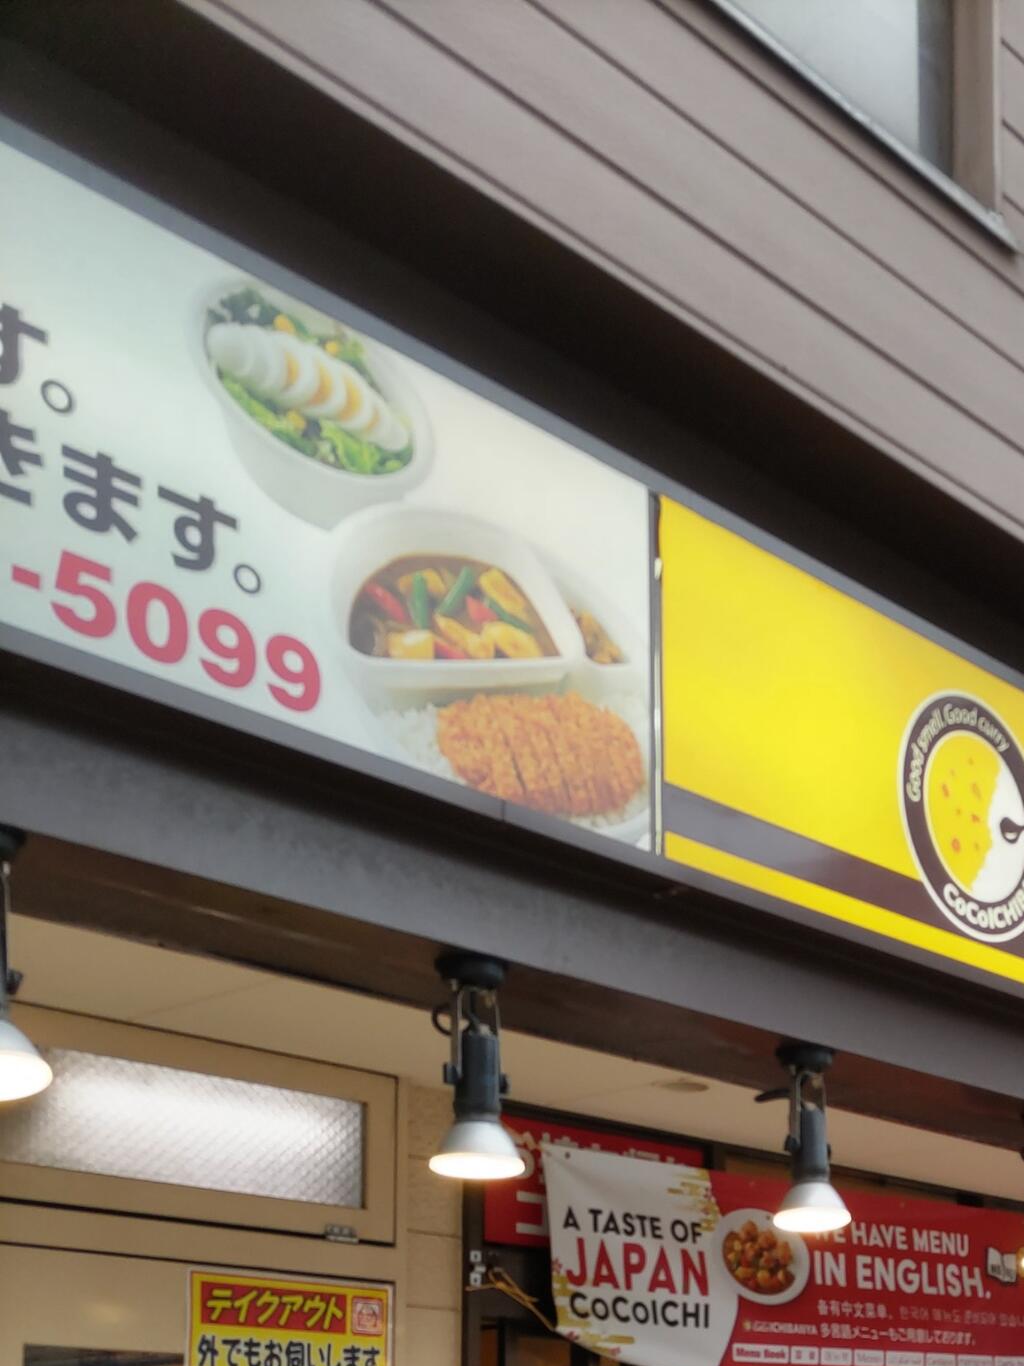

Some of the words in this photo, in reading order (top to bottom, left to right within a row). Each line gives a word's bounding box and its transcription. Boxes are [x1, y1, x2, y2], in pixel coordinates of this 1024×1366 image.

[11, 550, 322, 713] -5099
[563, 1206, 580, 1231] A
[588, 1208, 663, 1240] TASTE
[670, 1219, 703, 1244] OF
[851, 1221, 908, 1251] HAVE
[912, 1228, 970, 1257] MENU
[565, 1236, 709, 1297] JAPAN
[814, 1250, 847, 1287] IN
[856, 1254, 992, 1299] ENGLISH.
[207, 1289, 343, 1330] テイクアウト
[570, 1292, 709, 1329] CoCoICHI
